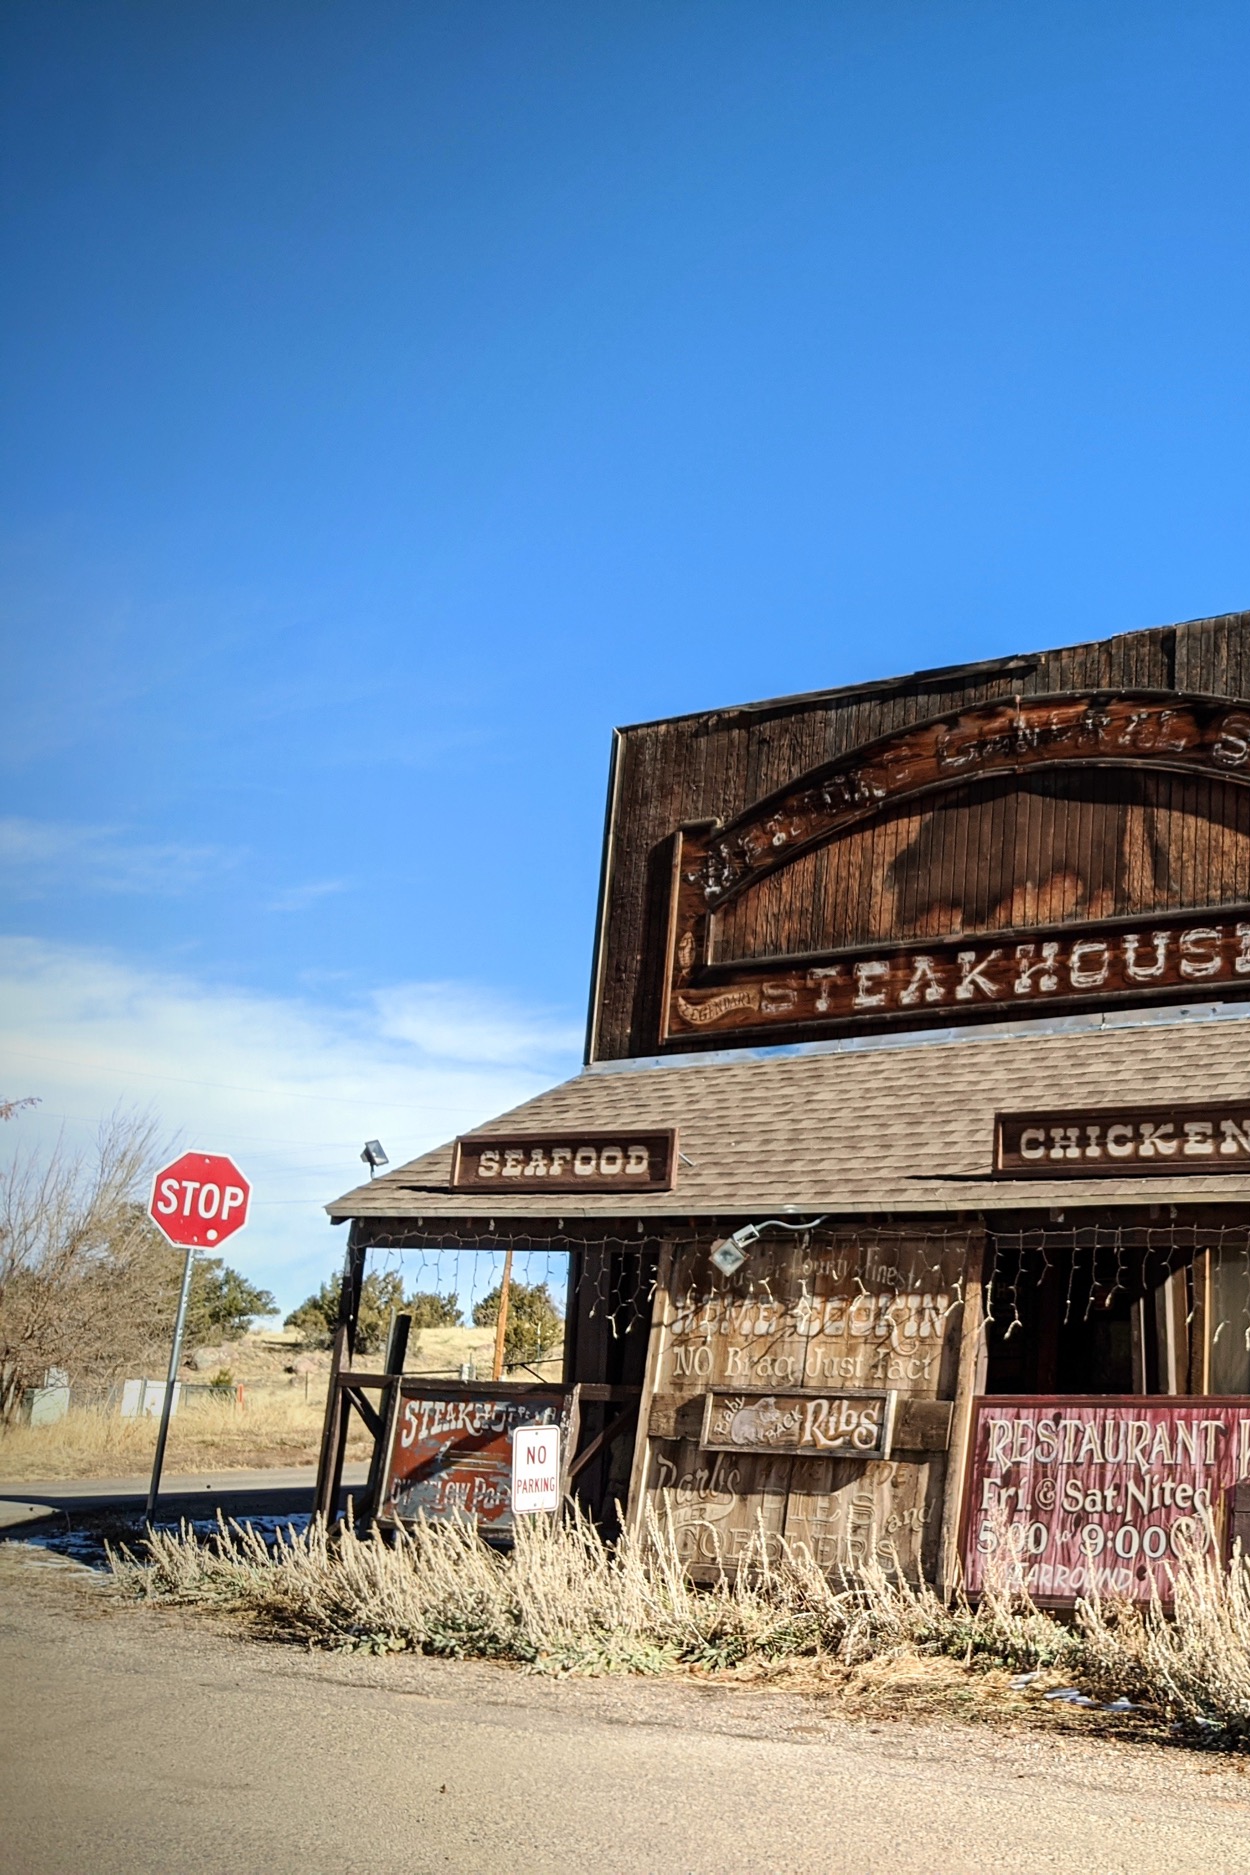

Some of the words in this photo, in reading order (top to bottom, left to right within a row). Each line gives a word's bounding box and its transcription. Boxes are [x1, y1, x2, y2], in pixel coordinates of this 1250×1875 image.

[477, 1145, 649, 1178] SEAFOOD
[157, 1178, 244, 1220] STOP
[671, 1295, 778, 1335] HOME
[672, 1346, 713, 1377] NO
[724, 1346, 795, 1387] Brag
[804, 1347, 864, 1379] Just
[873, 1348, 931, 1380] Fact
[401, 1401, 556, 1447] STEAKHO
[714, 1395, 745, 1436] Baby
[764, 1404, 803, 1442] BACK
[801, 1399, 880, 1450] Ribs
[527, 1445, 547, 1465] NO
[986, 1419, 1227, 1475] RESTAURANT
[517, 1477, 555, 1494] PARKING
[981, 1475, 1032, 1512] Fri.
[1035, 1478, 1056, 1511] &
[1061, 1479, 1124, 1514] Sat.
[1125, 1474, 1211, 1535] Nites
[887, 1499, 936, 1533] and
[977, 1520, 1048, 1555] 500
[1080, 1523, 1167, 1560] 9:00
